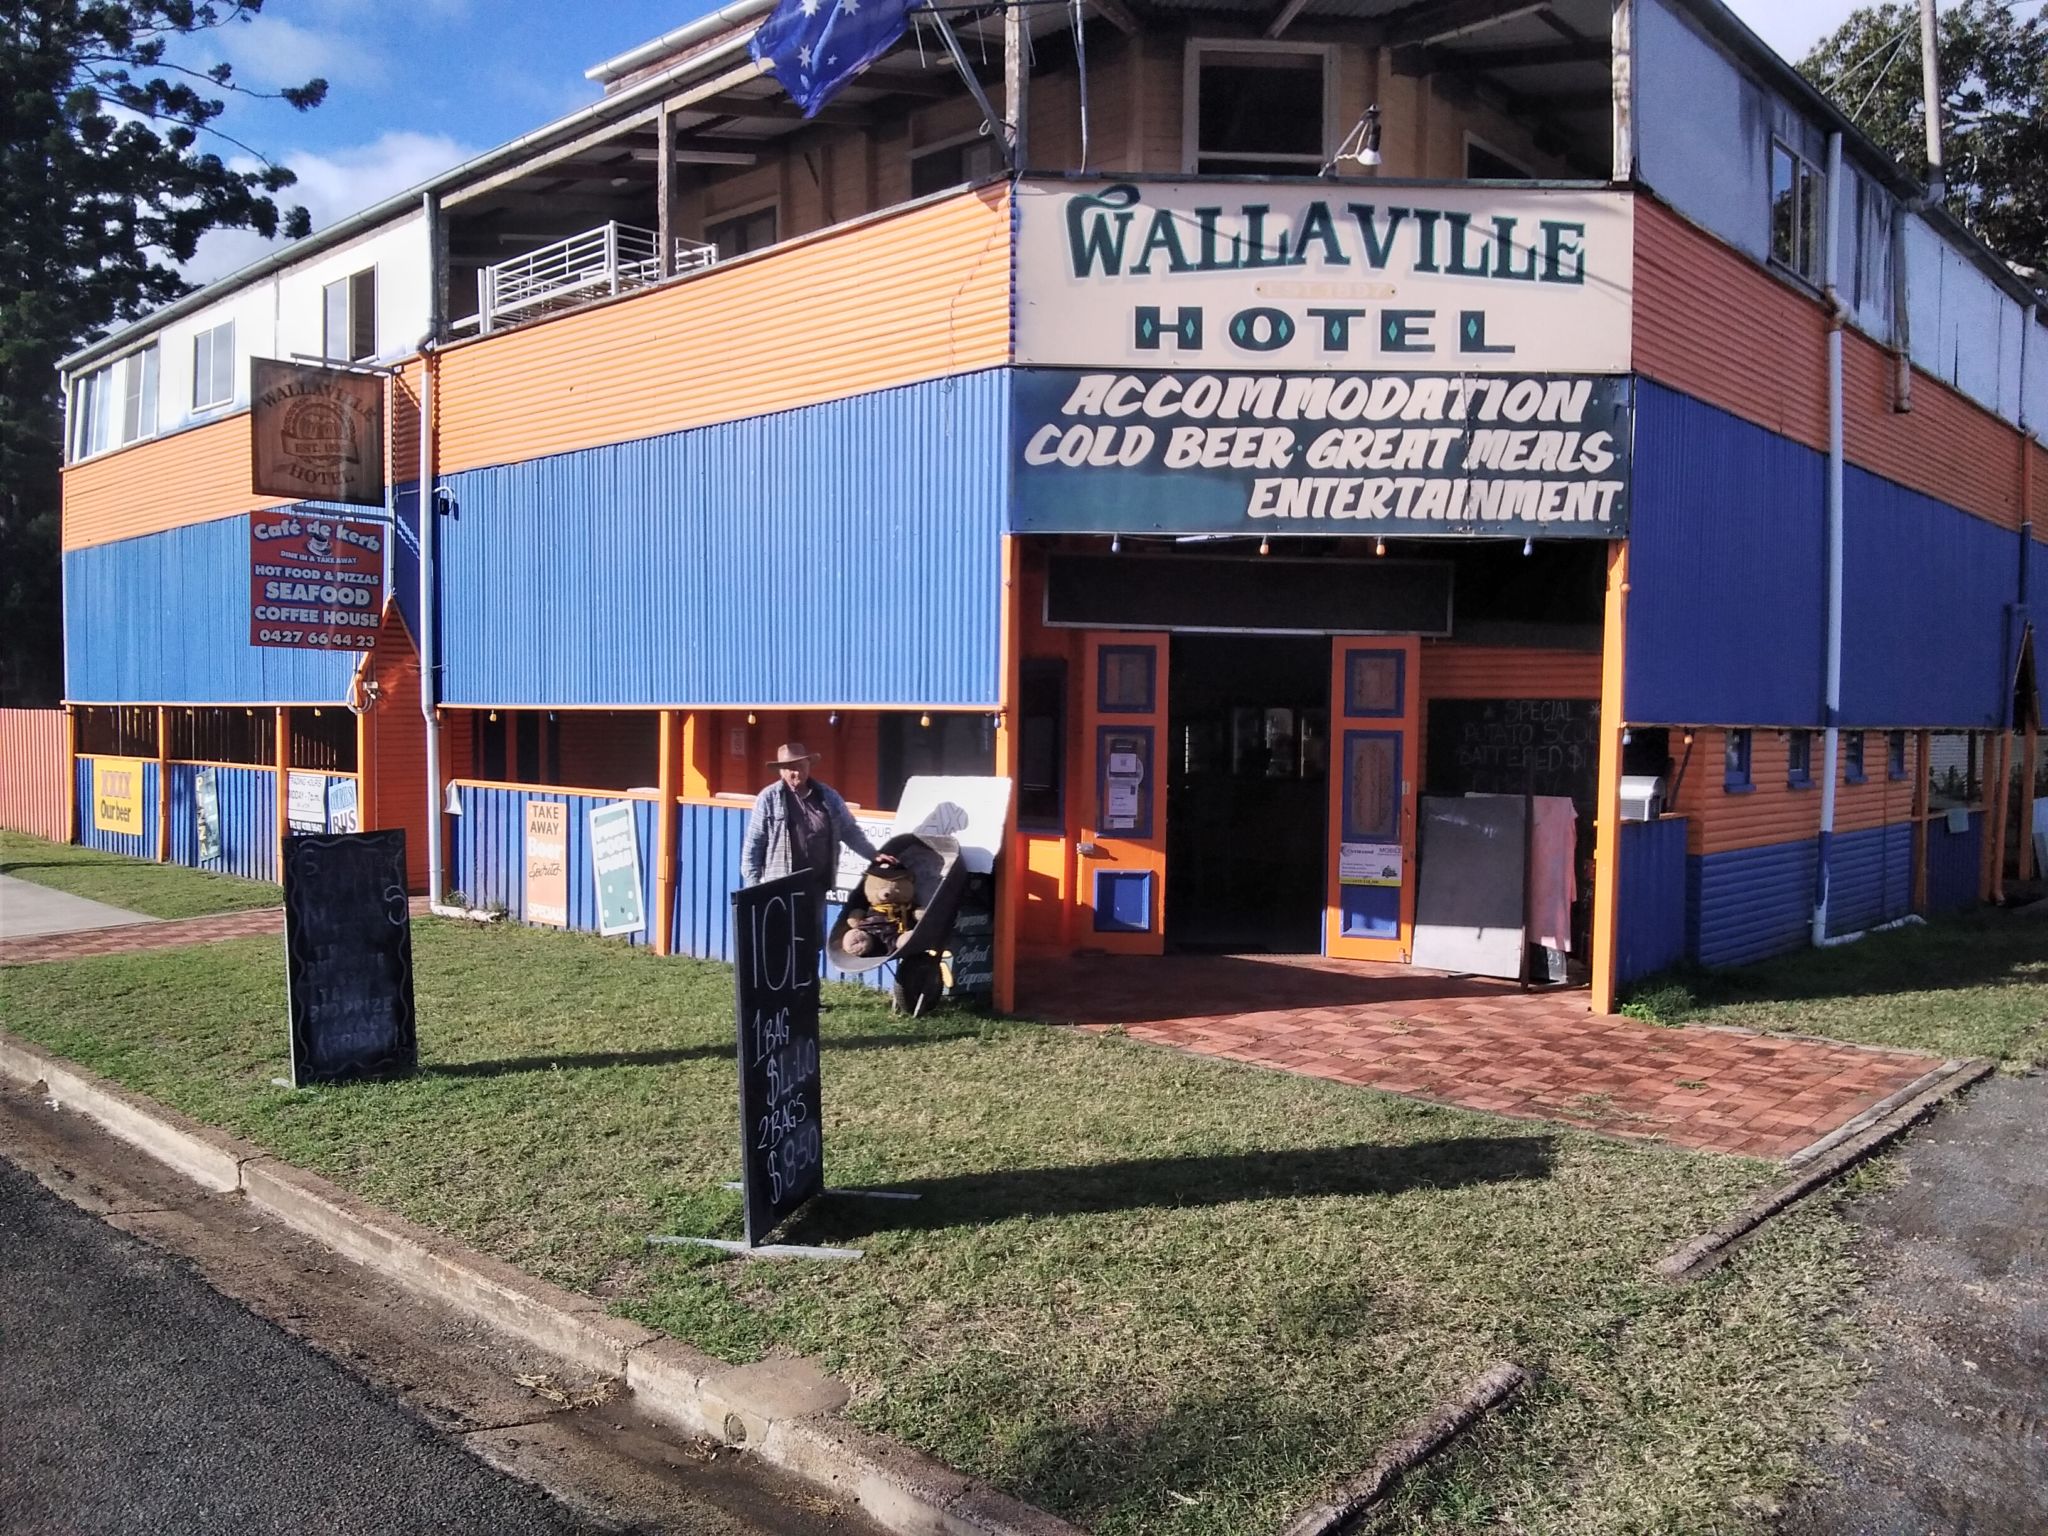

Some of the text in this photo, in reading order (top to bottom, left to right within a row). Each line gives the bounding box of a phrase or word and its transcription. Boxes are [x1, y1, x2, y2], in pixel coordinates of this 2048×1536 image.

[1064, 183, 1586, 286] WALLAVILLE
[1134, 305, 1516, 354] HOTEL
[1062, 374, 1592, 424] ACCOMMODATION
[1024, 423, 1615, 473] COLD BEER GREAT MEALS
[289, 463, 356, 485] HOTEL
[1247, 478, 1624, 522] ENTERTAINMENT
[253, 518, 381, 552] Café de kerb
[255, 564, 379, 585] HOT FOOD & PIZZAS
[265, 581, 371, 606] SEAFOOD
[254, 605, 379, 628] COFFEE HOUSE
[259, 629, 376, 647] 0427 66 44 23
[100, 799, 132, 822] Our beer
[195, 776, 209, 858] PIZZA
[530, 820, 560, 836] AWAY
[532, 805, 559, 820] TAKE
[751, 891, 813, 992] ICE
[753, 1006, 790, 1068] 1 BAG
[757, 1093, 807, 1150] 2 BAGS
